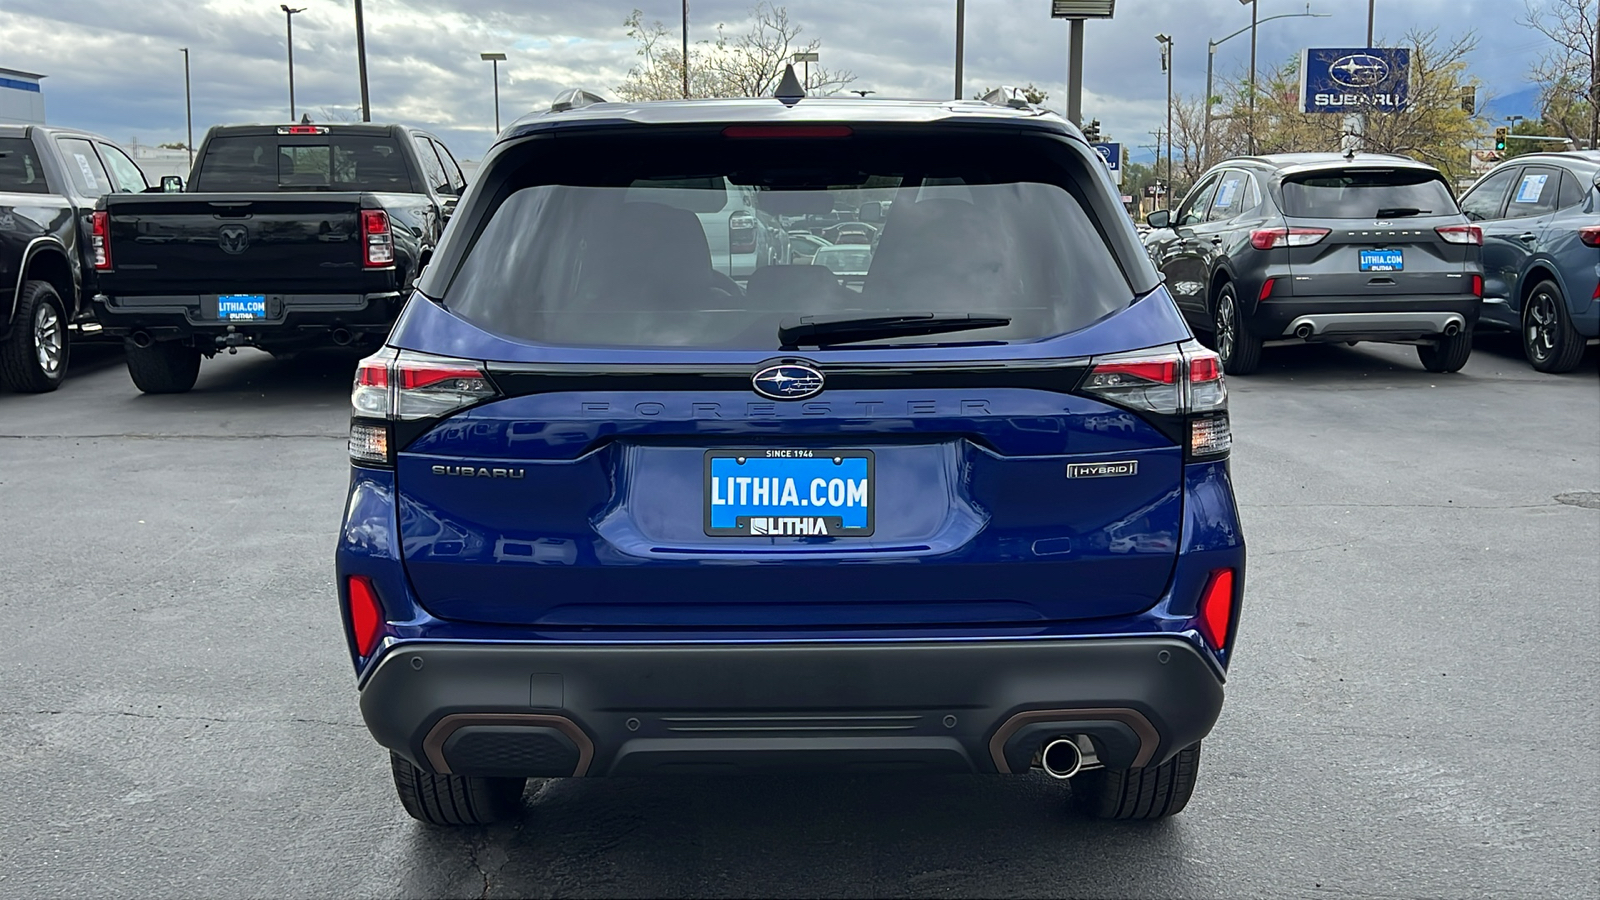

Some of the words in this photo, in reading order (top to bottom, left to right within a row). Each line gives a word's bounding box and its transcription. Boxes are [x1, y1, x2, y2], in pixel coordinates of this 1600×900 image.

[1361, 255, 1403, 264] LITHIA.COM
[219, 302, 265, 312] LITHIA.COM
[581, 400, 991, 418] FORESTER
[766, 450, 792, 458] SINCE
[794, 450, 813, 458] 1946
[431, 465, 525, 479] SUBARU
[1080, 466, 1128, 475] HYBRID
[712, 476, 868, 508] LITHIA.COM
[767, 517, 828, 535] LITHIA
